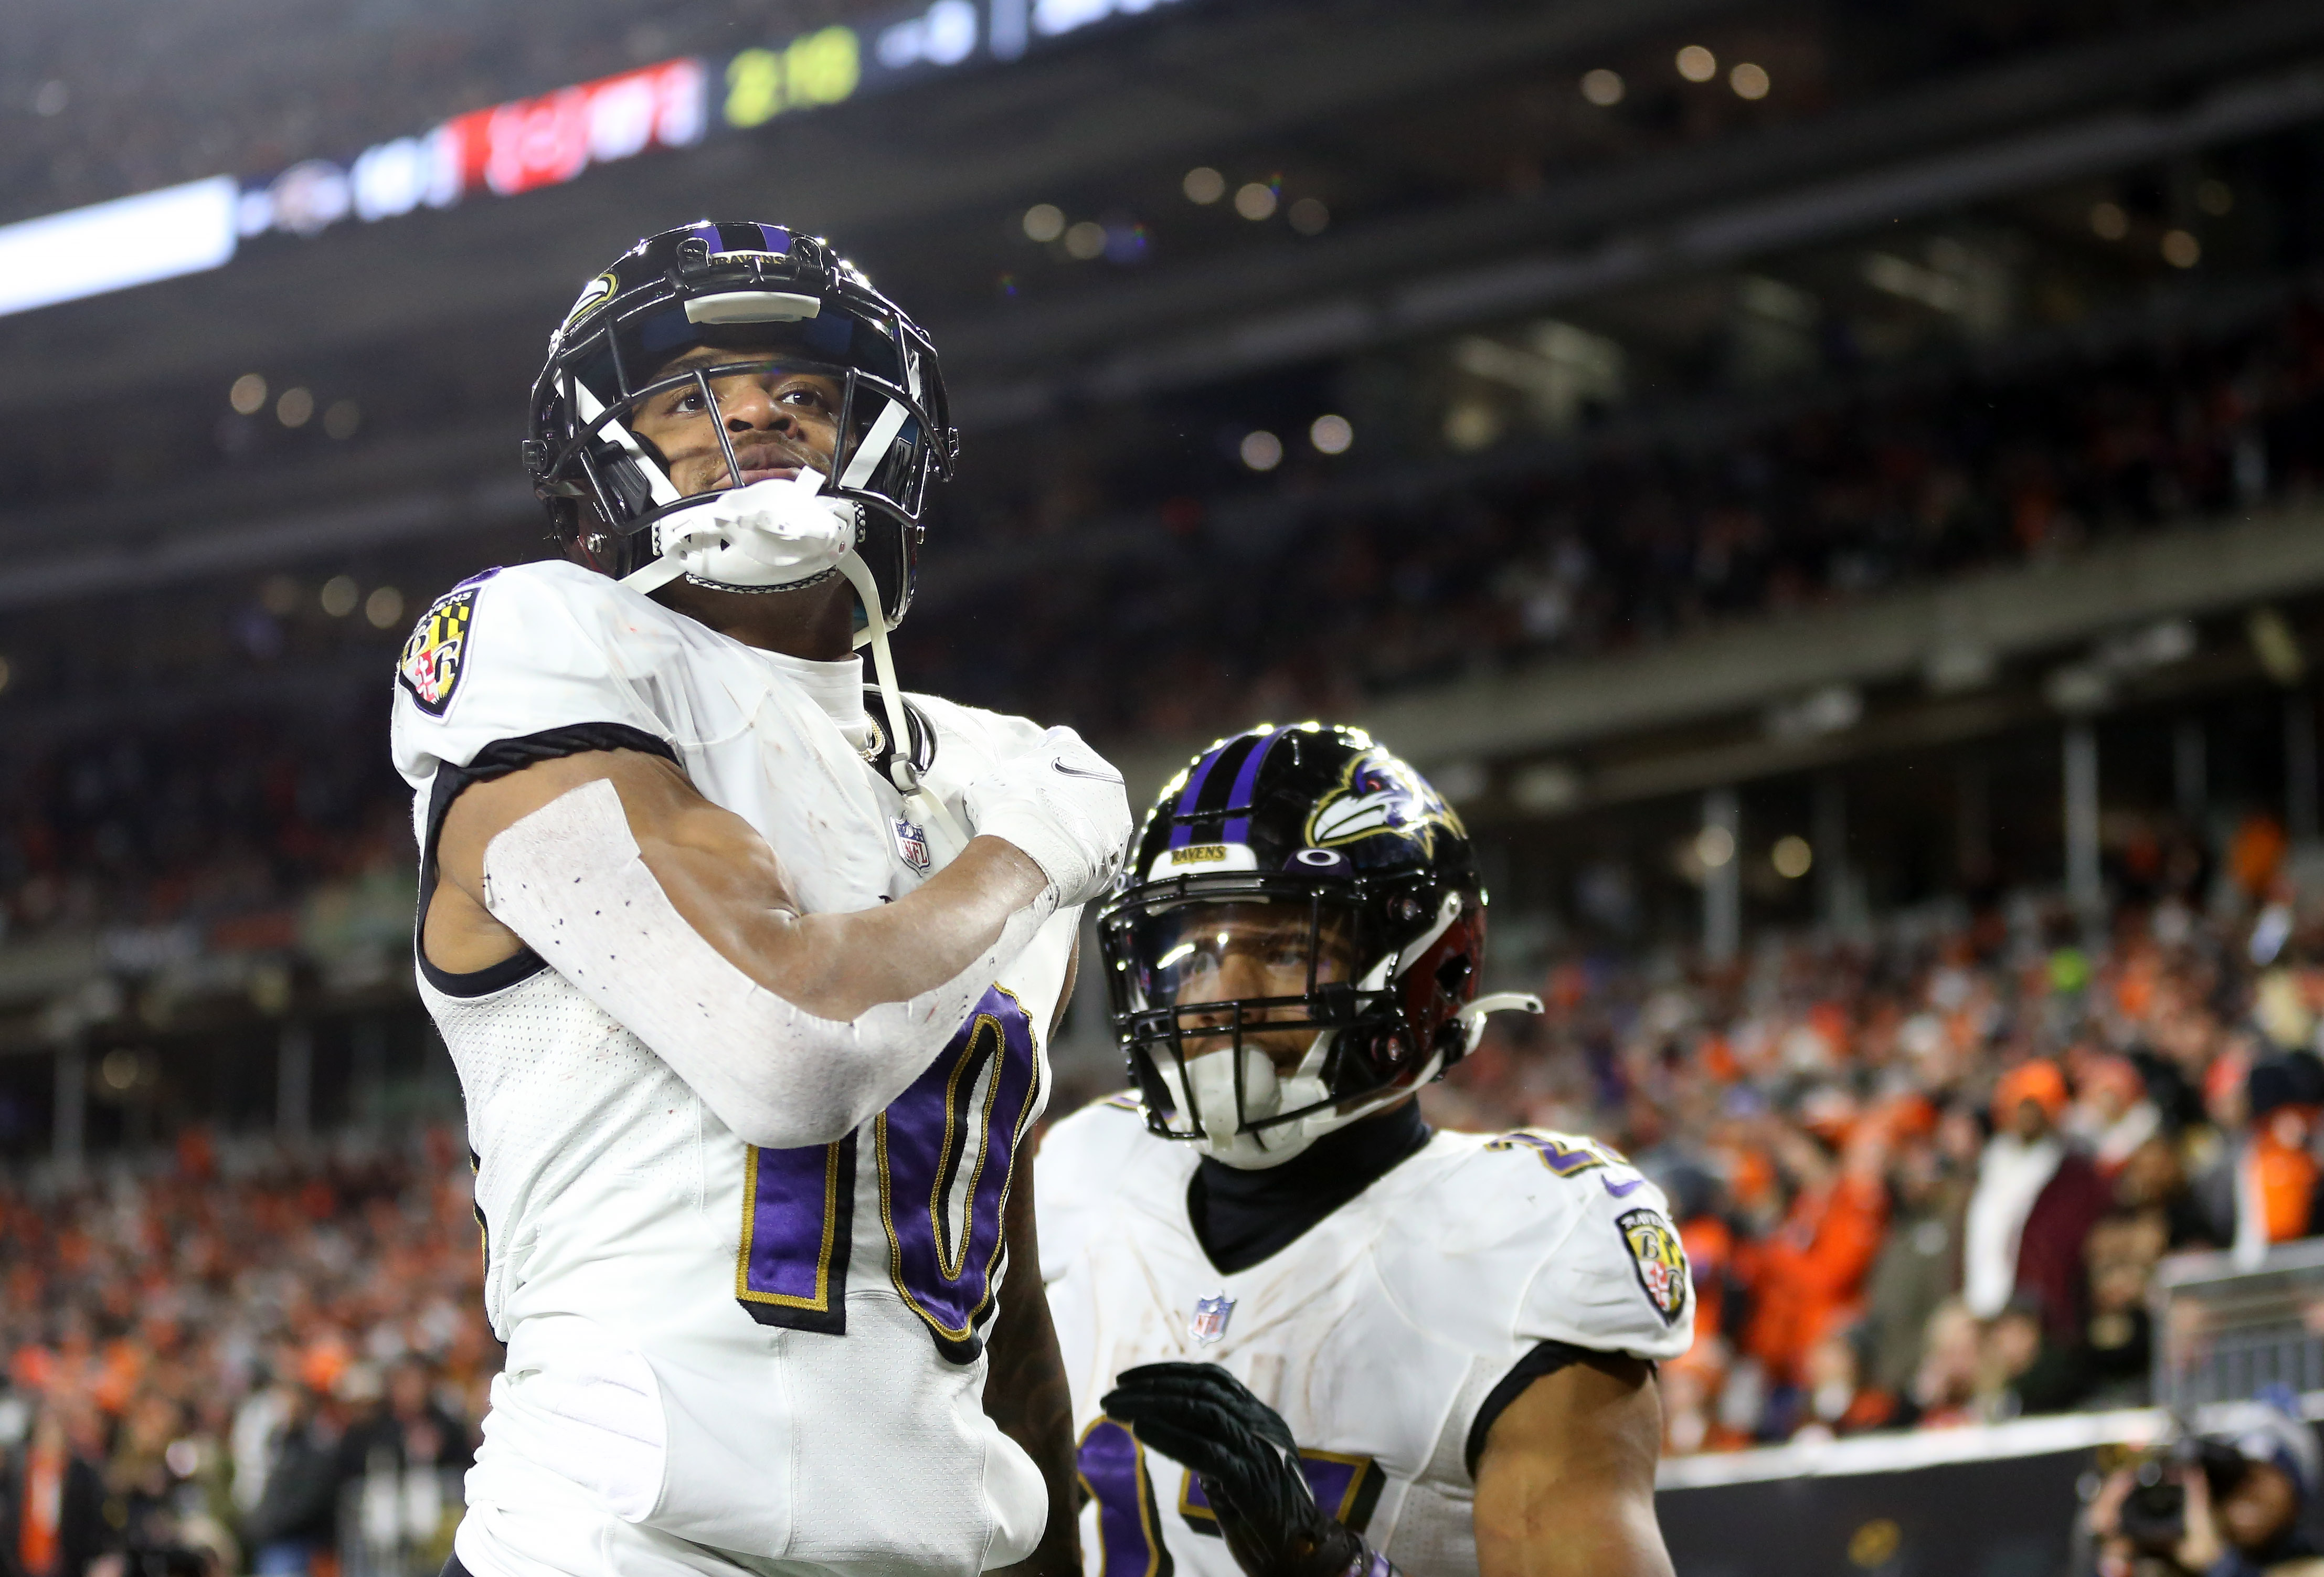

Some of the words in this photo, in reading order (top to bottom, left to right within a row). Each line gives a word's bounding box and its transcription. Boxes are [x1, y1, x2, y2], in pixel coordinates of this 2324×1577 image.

[711, 254, 787, 266] RAVNS
[903, 840, 928, 864] NFL
[1171, 846, 1226, 865] RAVENS
